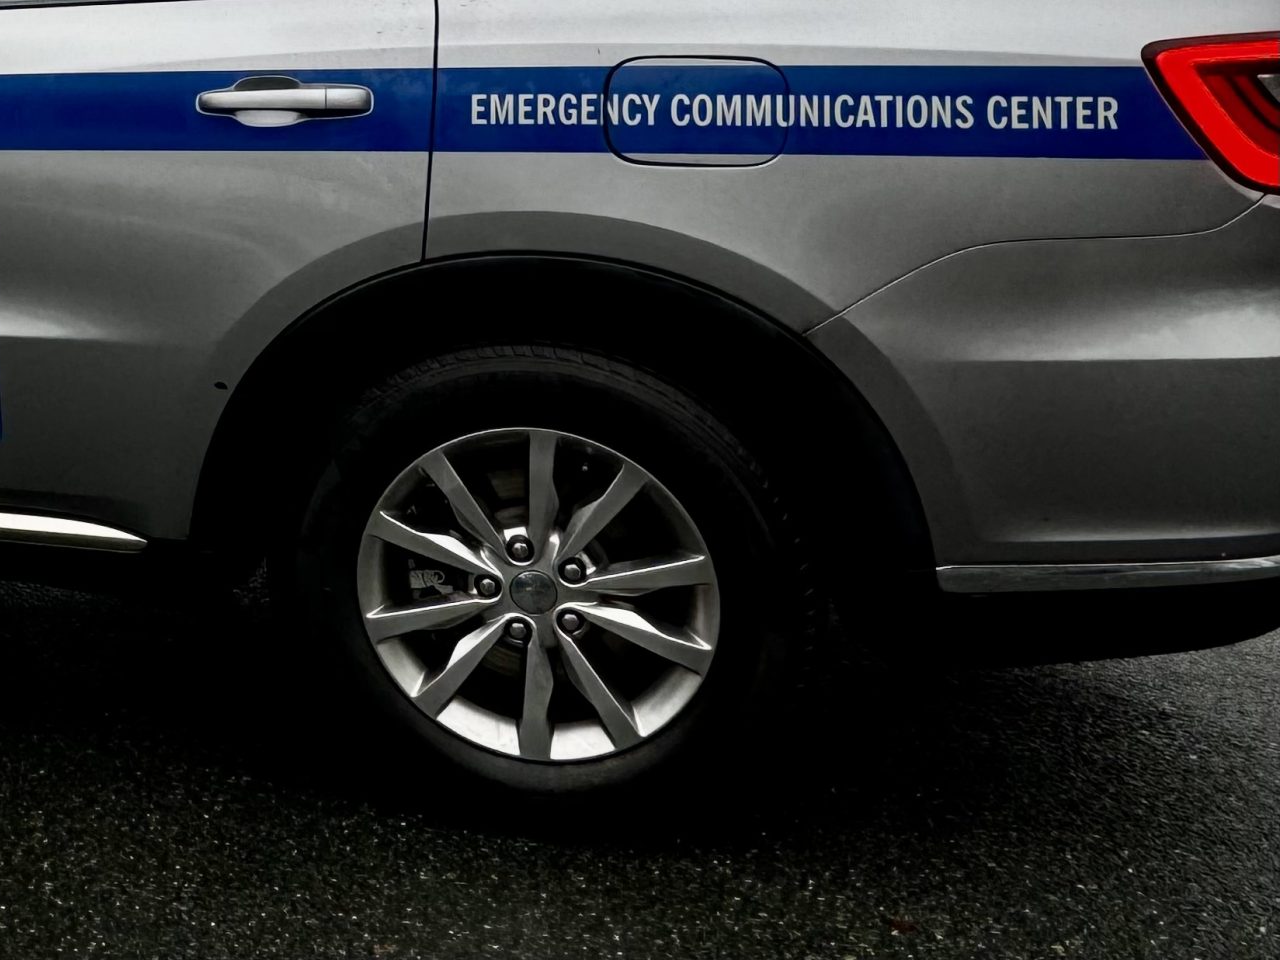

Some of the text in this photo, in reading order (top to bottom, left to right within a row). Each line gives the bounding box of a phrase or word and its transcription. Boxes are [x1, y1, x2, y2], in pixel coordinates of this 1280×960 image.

[471, 93, 1119, 130] EMERGENCY COMMUNICATIONS CENTER
